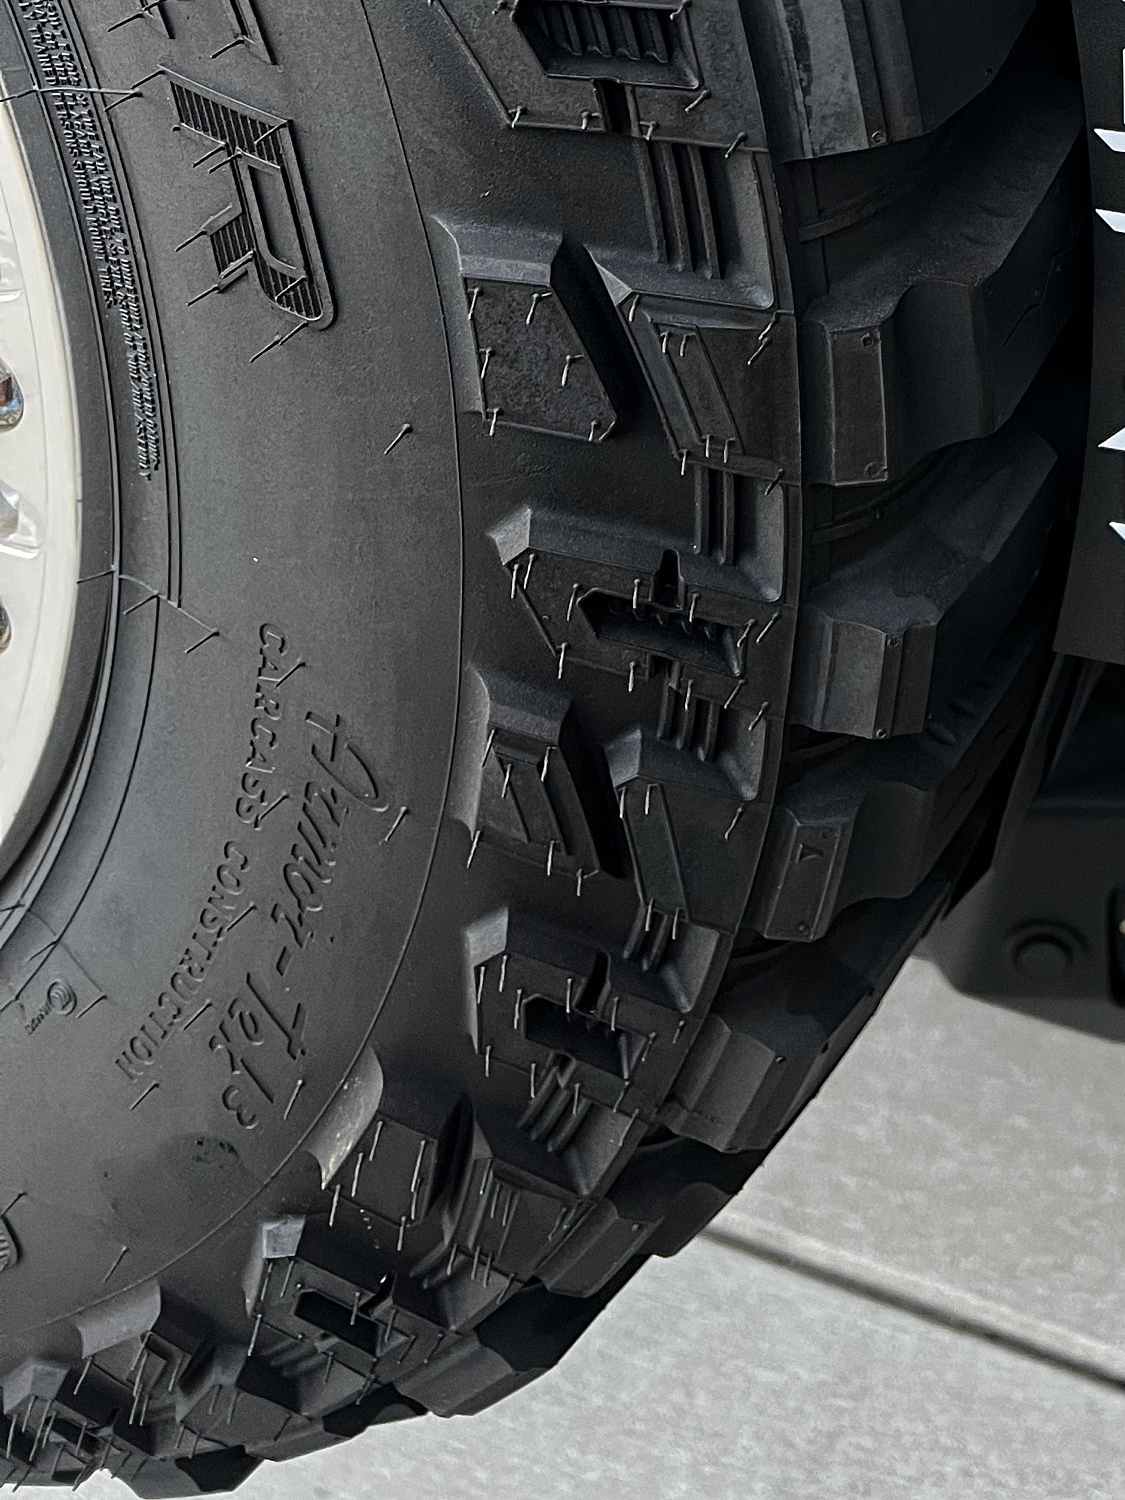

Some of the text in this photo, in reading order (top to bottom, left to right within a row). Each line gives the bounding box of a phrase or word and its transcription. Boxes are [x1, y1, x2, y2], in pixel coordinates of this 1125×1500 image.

[29, 24, 59, 86] TRAINED
[51, 88, 81, 158] PERSONS
[71, 157, 96, 214] SHOULD
[86, 213, 108, 264] MOUNT
[64, 89, 92, 158] PLACARD
[80, 108, 99, 143] TIRE
[90, 142, 115, 205] FAILURE
[107, 204, 123, 235] DUE
[115, 237, 127, 256] TO
[115, 622, 287, 1082] CARCASS CONSTRUCTION
